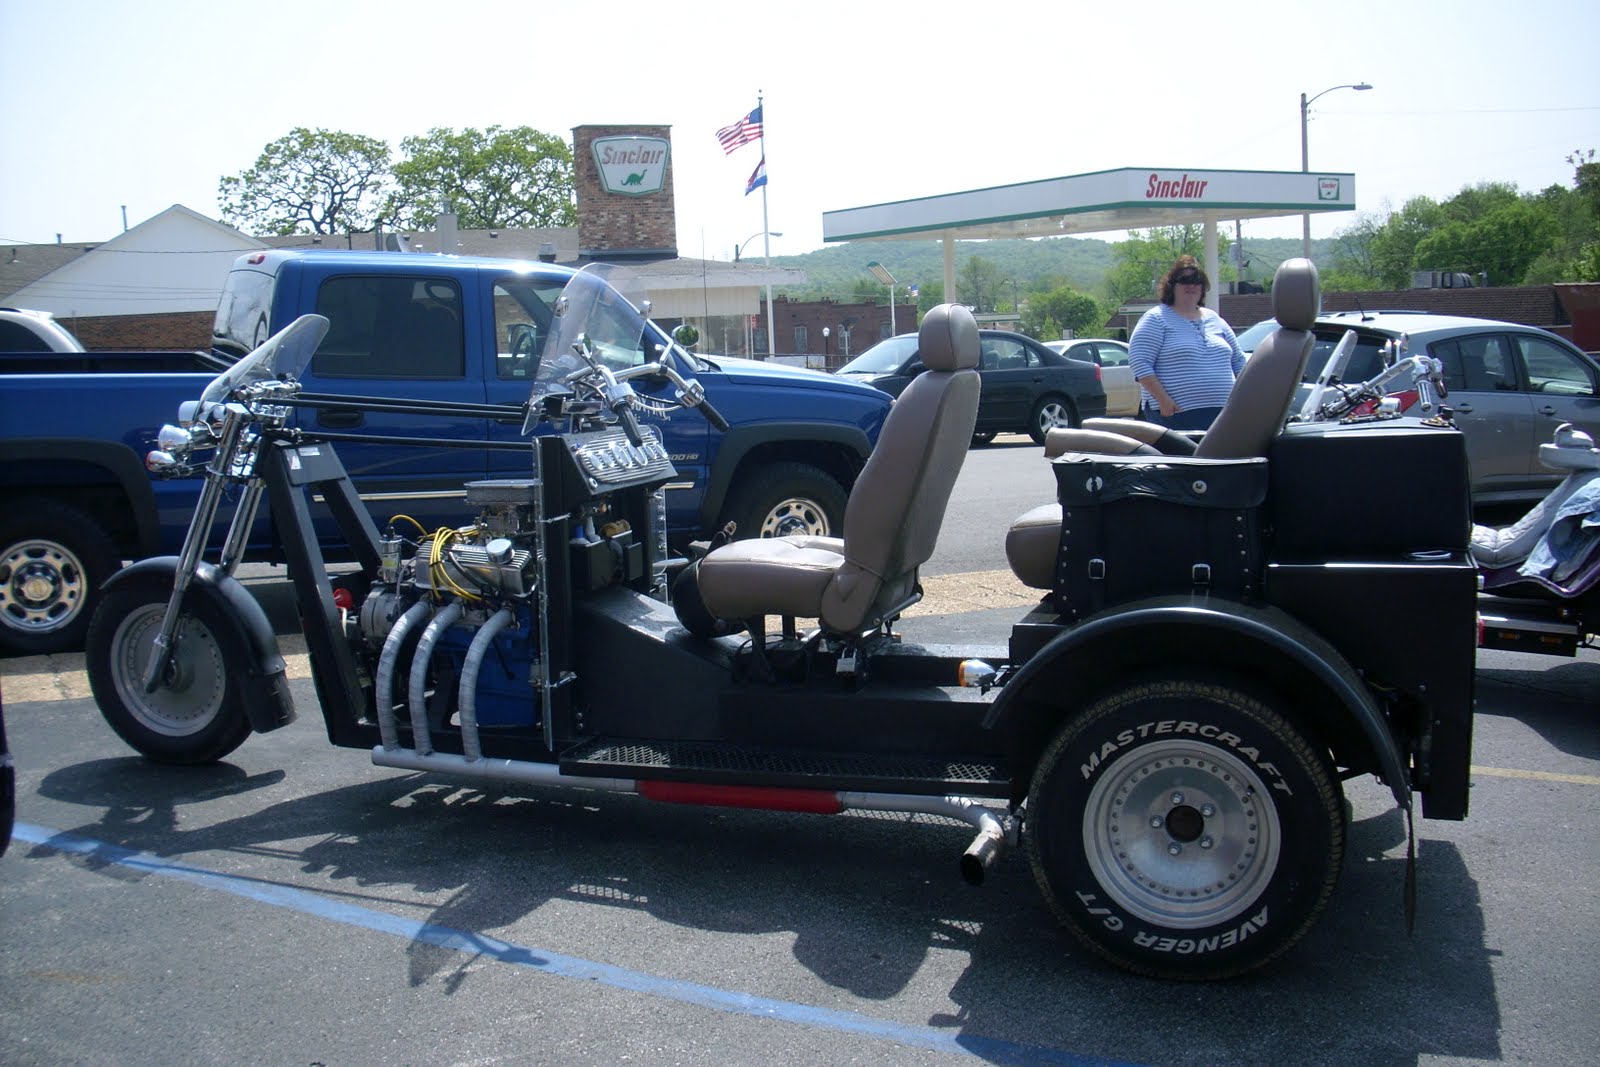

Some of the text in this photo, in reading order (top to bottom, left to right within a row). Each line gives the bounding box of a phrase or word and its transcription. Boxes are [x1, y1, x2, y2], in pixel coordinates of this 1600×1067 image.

[602, 144, 664, 165] Sinclair
[1146, 173, 1208, 199] Sinclair
[1080, 719, 1294, 796] MASTERCRAFT
[1133, 905, 1270, 955] AVENGER
